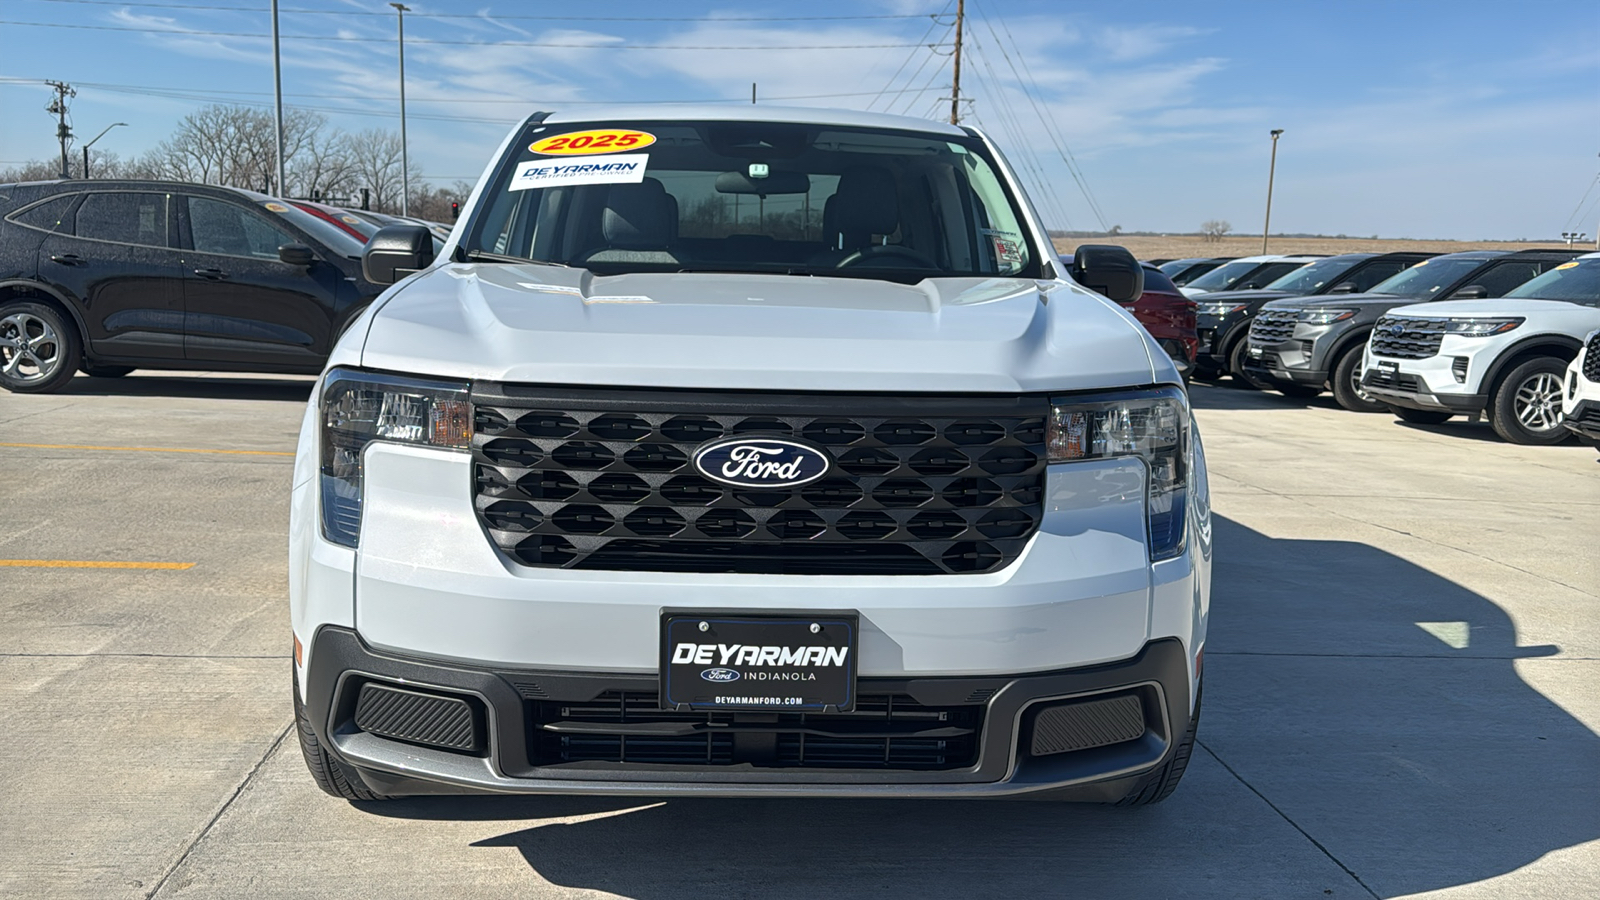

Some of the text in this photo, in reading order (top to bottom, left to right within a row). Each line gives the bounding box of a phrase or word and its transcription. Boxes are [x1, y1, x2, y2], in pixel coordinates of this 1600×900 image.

[541, 134, 643, 151] 2025
[522, 163, 638, 177] DEYARMAN
[529, 172, 577, 180] CERTIFIED
[722, 445, 803, 479] Ford
[671, 643, 849, 667] DEYARMAN
[708, 670, 816, 681] Ford INDIANOLA
[715, 696, 803, 705] DEYARMANFORD.COM
